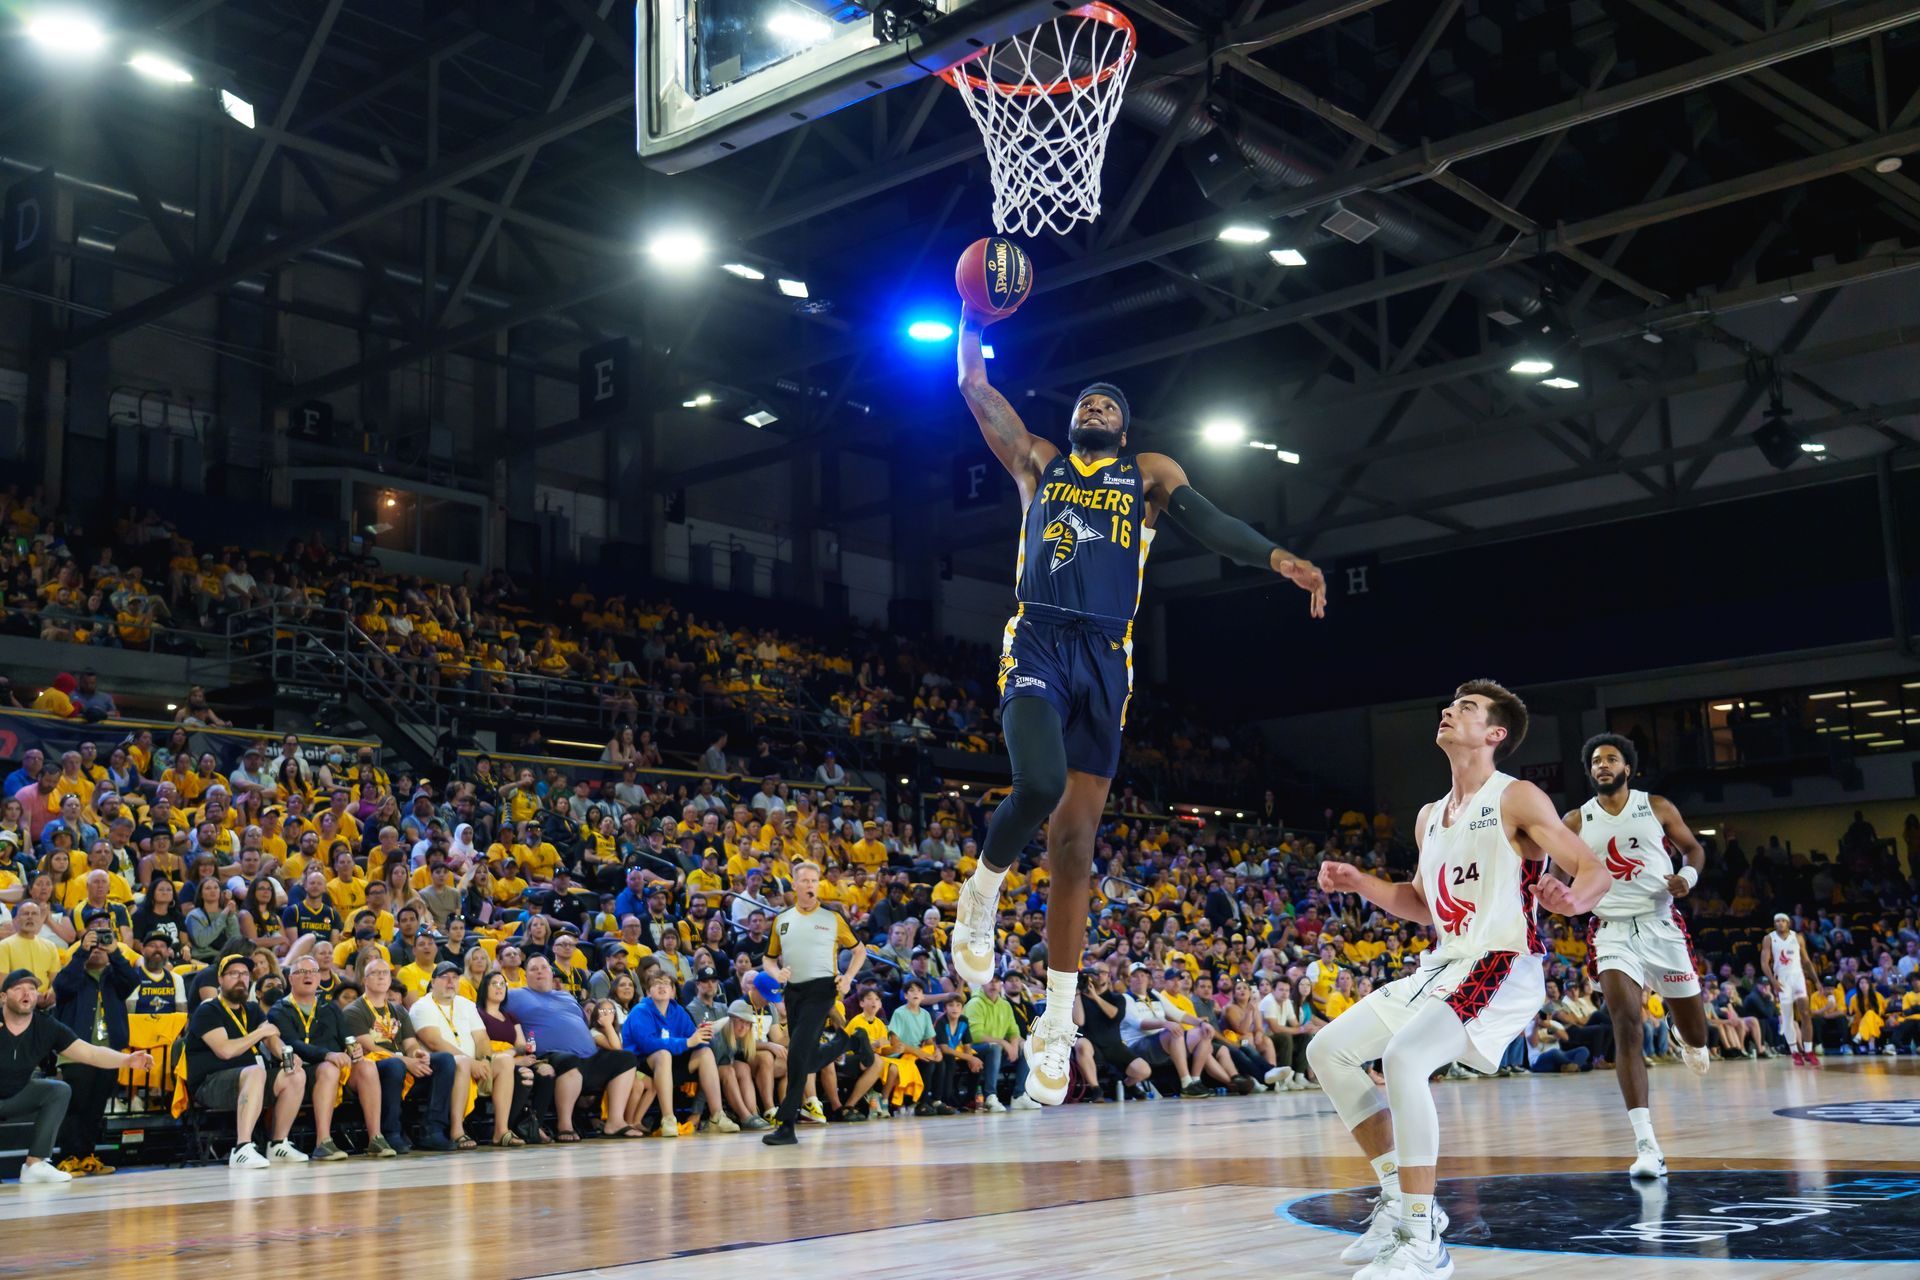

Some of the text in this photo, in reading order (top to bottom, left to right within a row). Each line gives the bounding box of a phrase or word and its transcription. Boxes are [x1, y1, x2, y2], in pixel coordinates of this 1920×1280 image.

[14, 198, 40, 252] D
[995, 243, 1007, 293] SPALDING
[1013, 246, 1026, 293] LEGACY
[594, 358, 614, 401] E
[967, 464, 986, 499] F
[1103, 476, 1135, 484] STINGERS
[1041, 483, 1134, 516] STINGERS
[1111, 515, 1132, 549] 16
[1345, 565, 1369, 595] H
[1016, 677, 1046, 688] STINGERS
[1525, 765, 1558, 778] EXIT
[1628, 837, 1640, 849] 2
[1453, 862, 1480, 885] 24
[141, 987, 175, 996] STINGERS
[1663, 973, 1695, 983] SURGE
